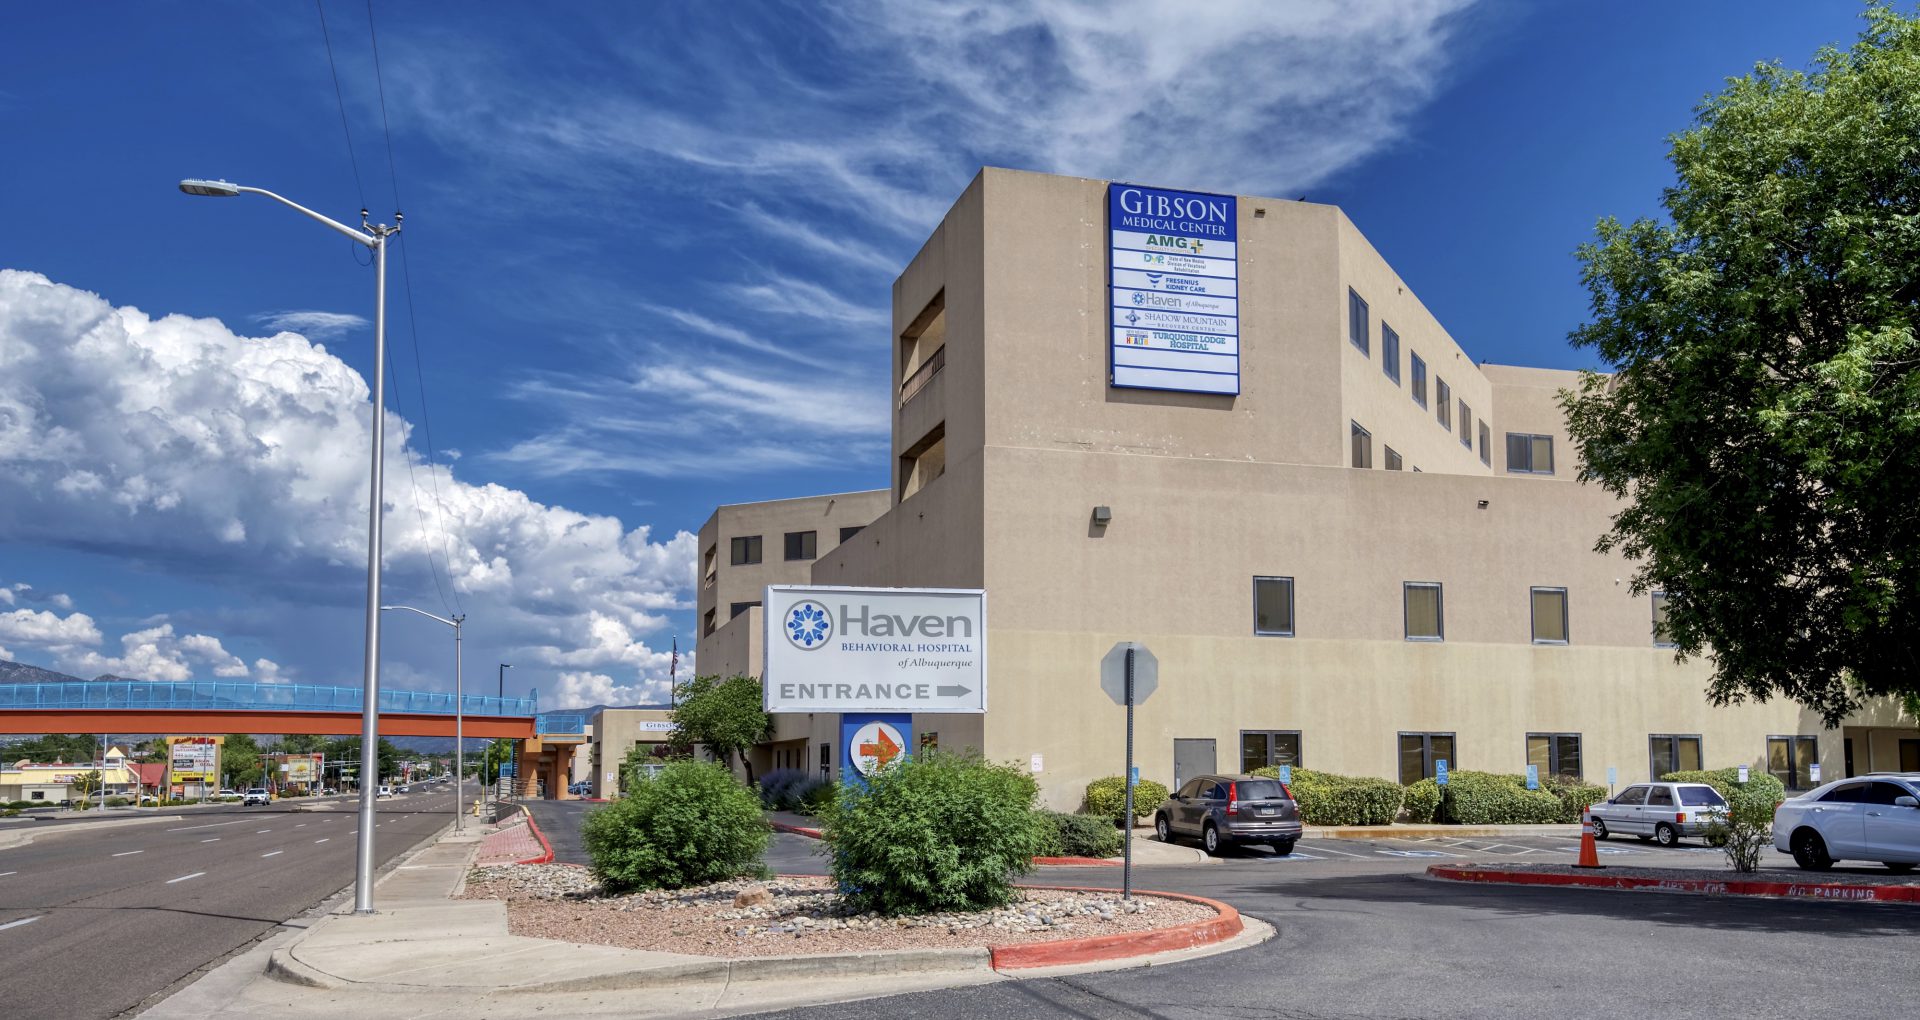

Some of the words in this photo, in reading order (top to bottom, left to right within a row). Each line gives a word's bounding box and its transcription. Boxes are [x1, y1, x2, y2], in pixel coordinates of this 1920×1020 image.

[1120, 189, 1227, 223] GIBSON
[1122, 216, 1177, 231] MEDICAL
[1180, 222, 1227, 236] CENTER
[1146, 234, 1188, 249] AMG
[1165, 277, 1199, 286] FRESENIUS
[1146, 292, 1182, 308] Haven
[1144, 312, 1181, 323] SHADOW
[1182, 315, 1227, 327] MOUNTAIN
[1157, 322, 1189, 330] RECOVERY
[1152, 331, 1198, 343] TURQUOISE
[1199, 335, 1226, 345] LODGE
[1170, 340, 1209, 351] HOSPITAL
[839, 604, 972, 638] Haven
[841, 642, 914, 652] BEHAVIORAL
[917, 644, 972, 652] HOSPITAL
[898, 658, 908, 668] of
[910, 657, 973, 670] Albuquerque
[779, 683, 930, 699] ENTRANCE
[1789, 884, 1806, 896] NO
[1814, 887, 1875, 900] PARKING
